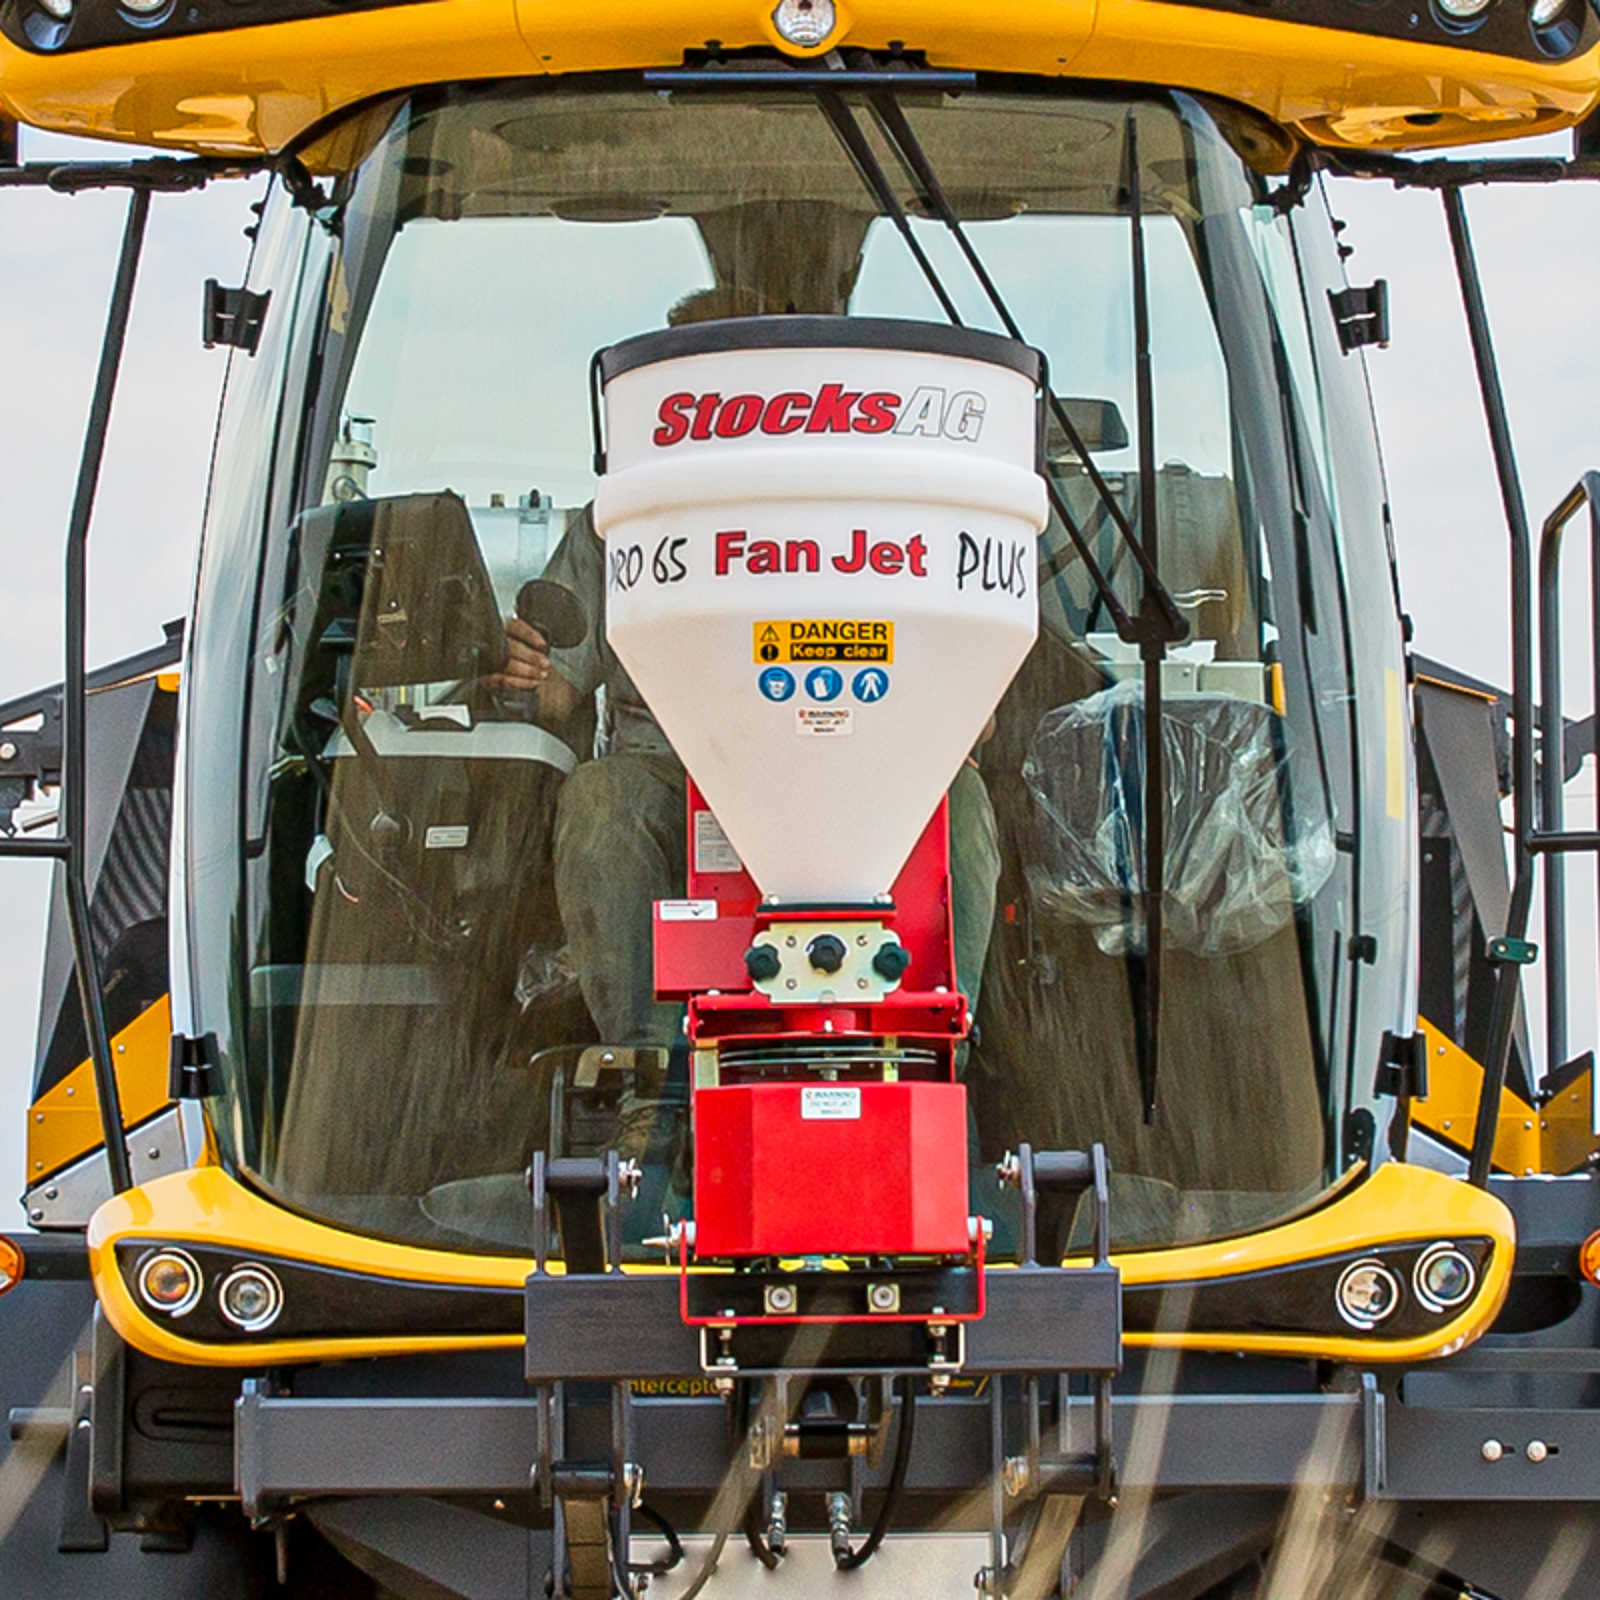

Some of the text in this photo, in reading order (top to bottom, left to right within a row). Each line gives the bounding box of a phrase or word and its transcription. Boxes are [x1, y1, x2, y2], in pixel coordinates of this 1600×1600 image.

[652, 535, 688, 585] 65
[714, 529, 929, 578] Fan Jet
[956, 531, 1027, 599] PLUS
[790, 622, 888, 641] DANGER
[792, 644, 886, 660] Keep clear
